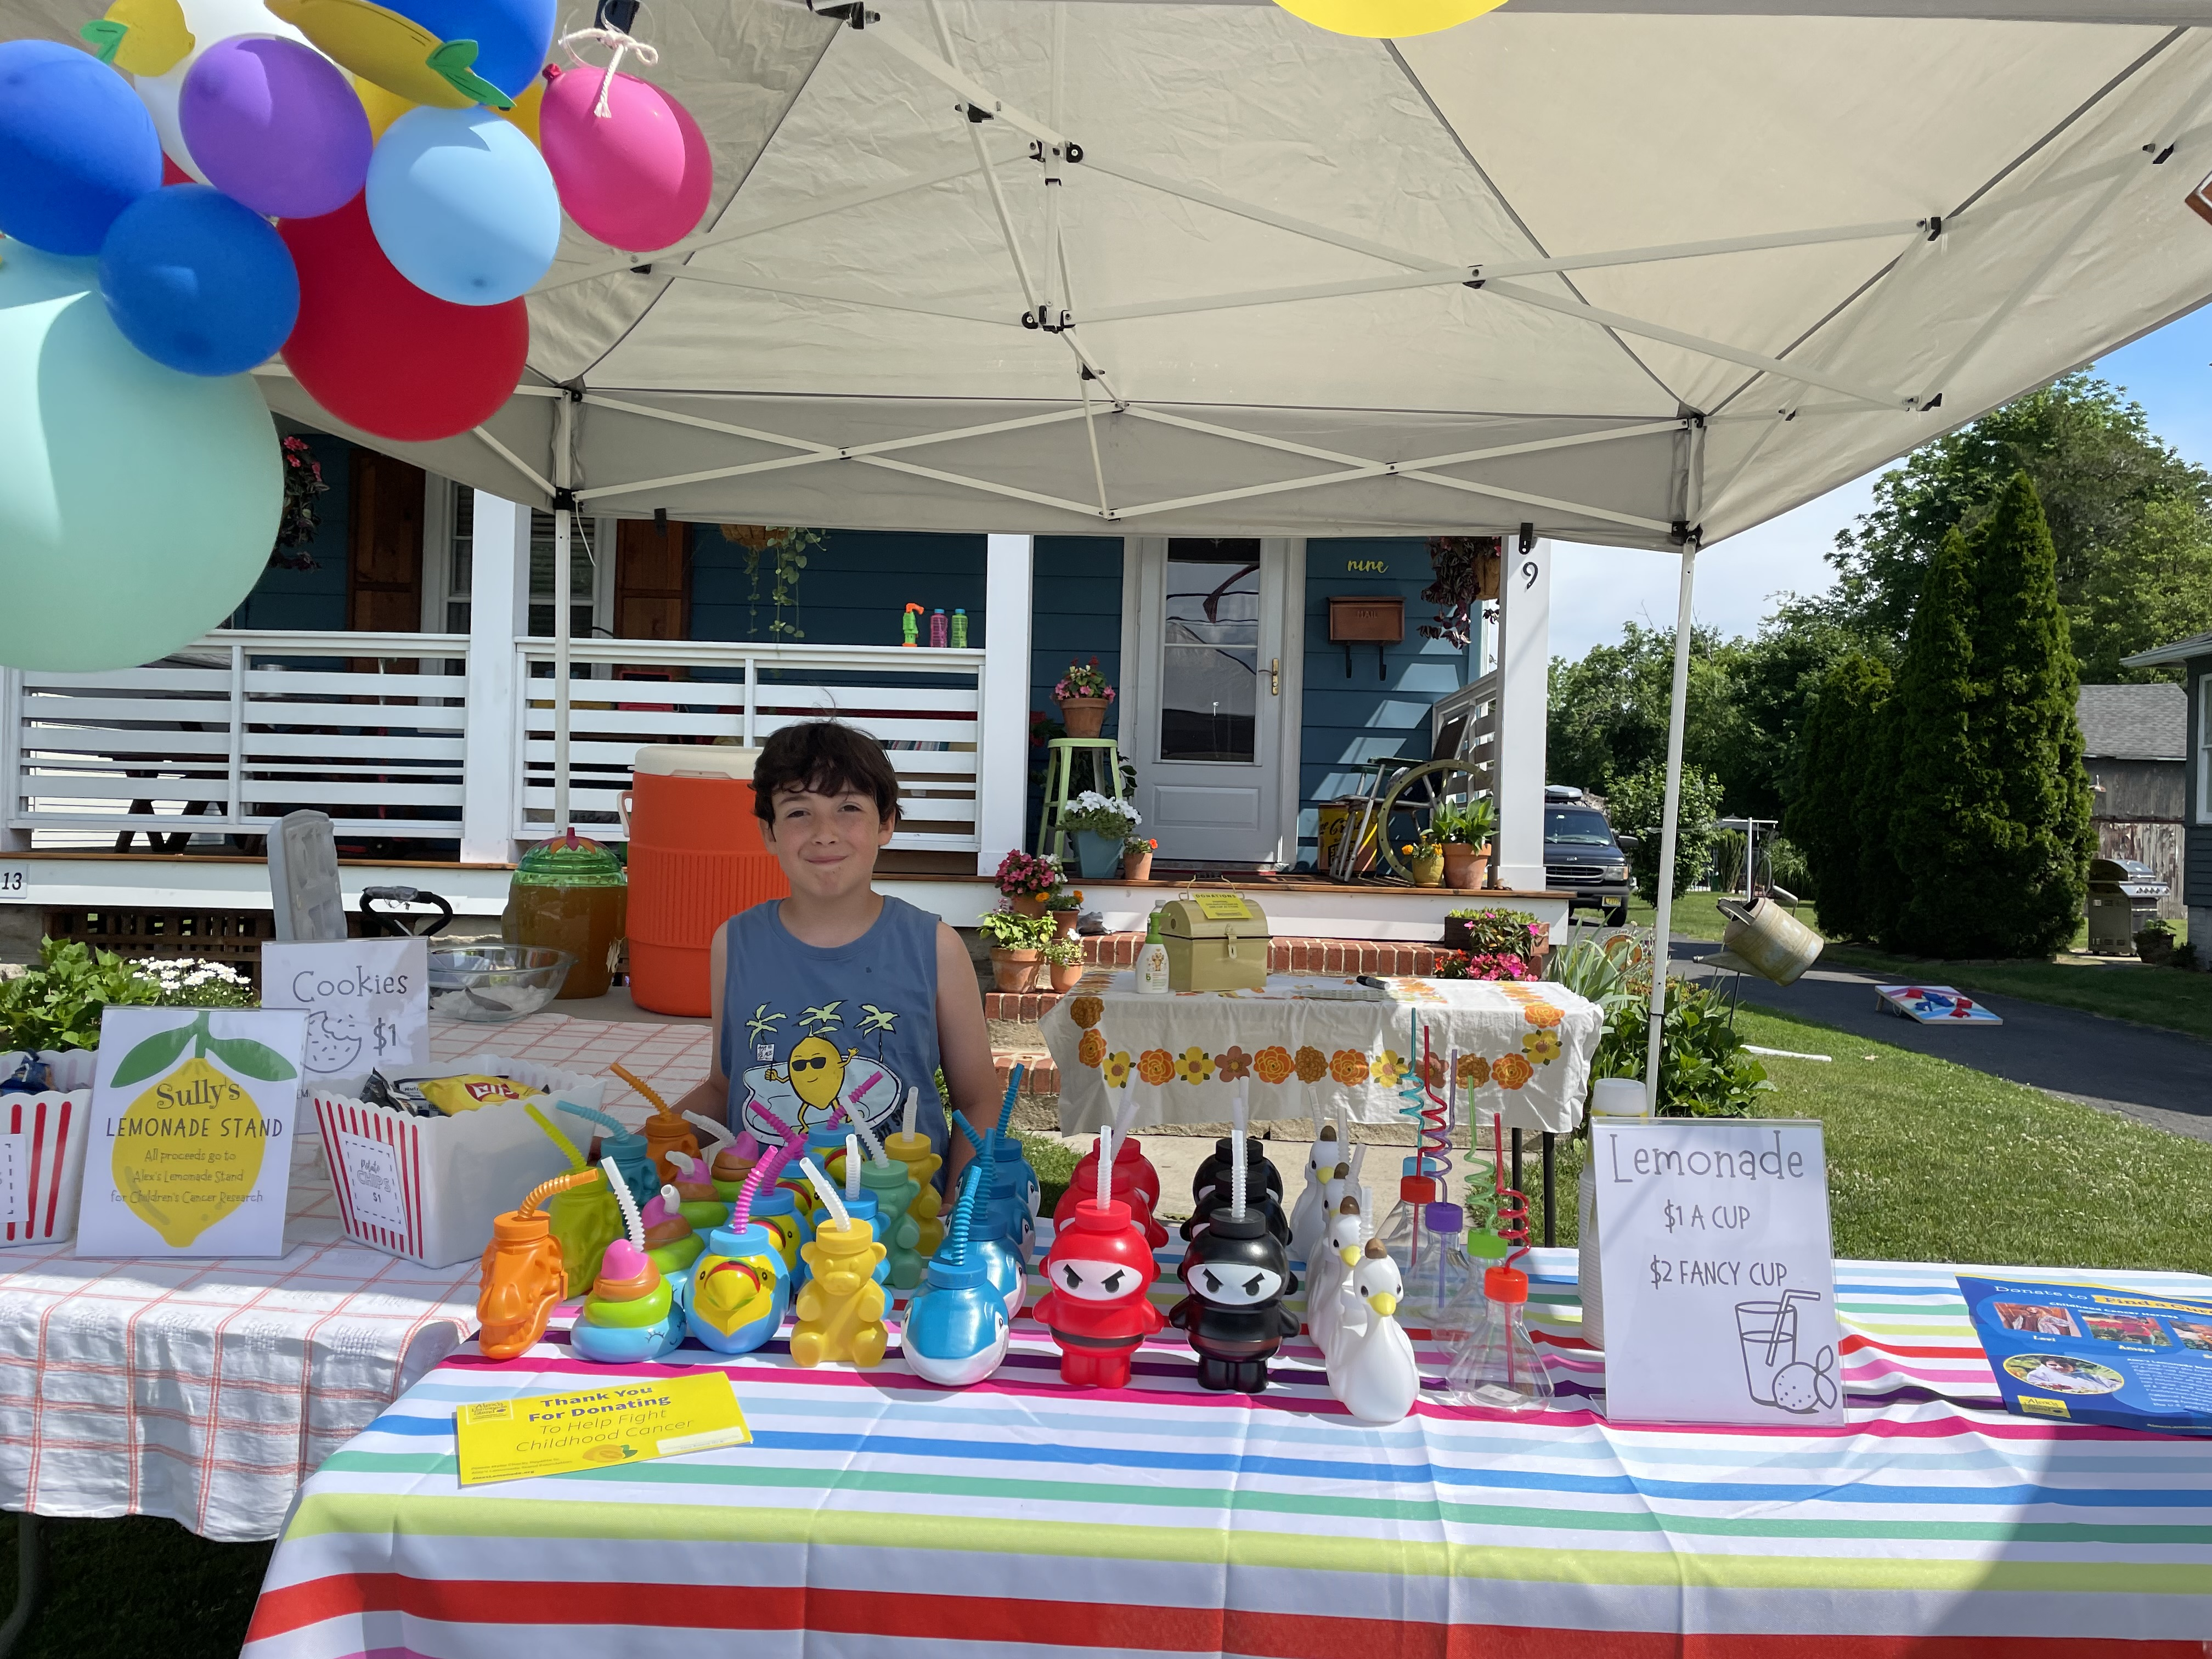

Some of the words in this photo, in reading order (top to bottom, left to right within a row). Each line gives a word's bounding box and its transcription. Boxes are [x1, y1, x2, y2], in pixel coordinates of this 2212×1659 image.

[1522, 561, 1538, 590] 9
[2, 872, 22, 890] 13
[292, 966, 408, 1002] Cookies
[373, 1017, 397, 1056] $1
[156, 1077, 240, 1109] Sully's
[106, 1118, 211, 1138] LEMONADE
[220, 1118, 283, 1138] STAND
[144, 1148, 159, 1162] All
[160, 1149, 206, 1163] proceeds
[207, 1153, 222, 1163] go
[224, 1150, 236, 1160] to
[360, 1159, 381, 1174] Potato
[1610, 1130, 1804, 1183] Lemonade
[133, 1169, 161, 1183] Alex's
[164, 1170, 213, 1183] Lemonade
[215, 1170, 244, 1183] Stand
[357, 1170, 391, 1193] CHIPS
[110, 1190, 127, 1203] for
[129, 1190, 179, 1203] Children's
[182, 1190, 217, 1203] Cancer
[218, 1190, 263, 1204] Research
[1665, 1199, 1684, 1233] $1
[1691, 1205, 1706, 1230] A
[1712, 1205, 1750, 1229] CUP
[1650, 1254, 1673, 1290] $2
[1679, 1261, 1741, 1286] FANCY
[1749, 1262, 1787, 1286] CUP
[1994, 1285, 2062, 1297] Donate
[2105, 1297, 2151, 1306] Find
[528, 1412, 566, 1422] For
[571, 1396, 672, 1417] Donating
[540, 1392, 610, 1408] Thank
[614, 1386, 653, 1397] You
[540, 1425, 561, 1435] To
[567, 1418, 612, 1432] Help
[618, 1409, 667, 1425] Fight
[516, 1429, 619, 1452] Childhood
[625, 1419, 694, 1437] Cancer
